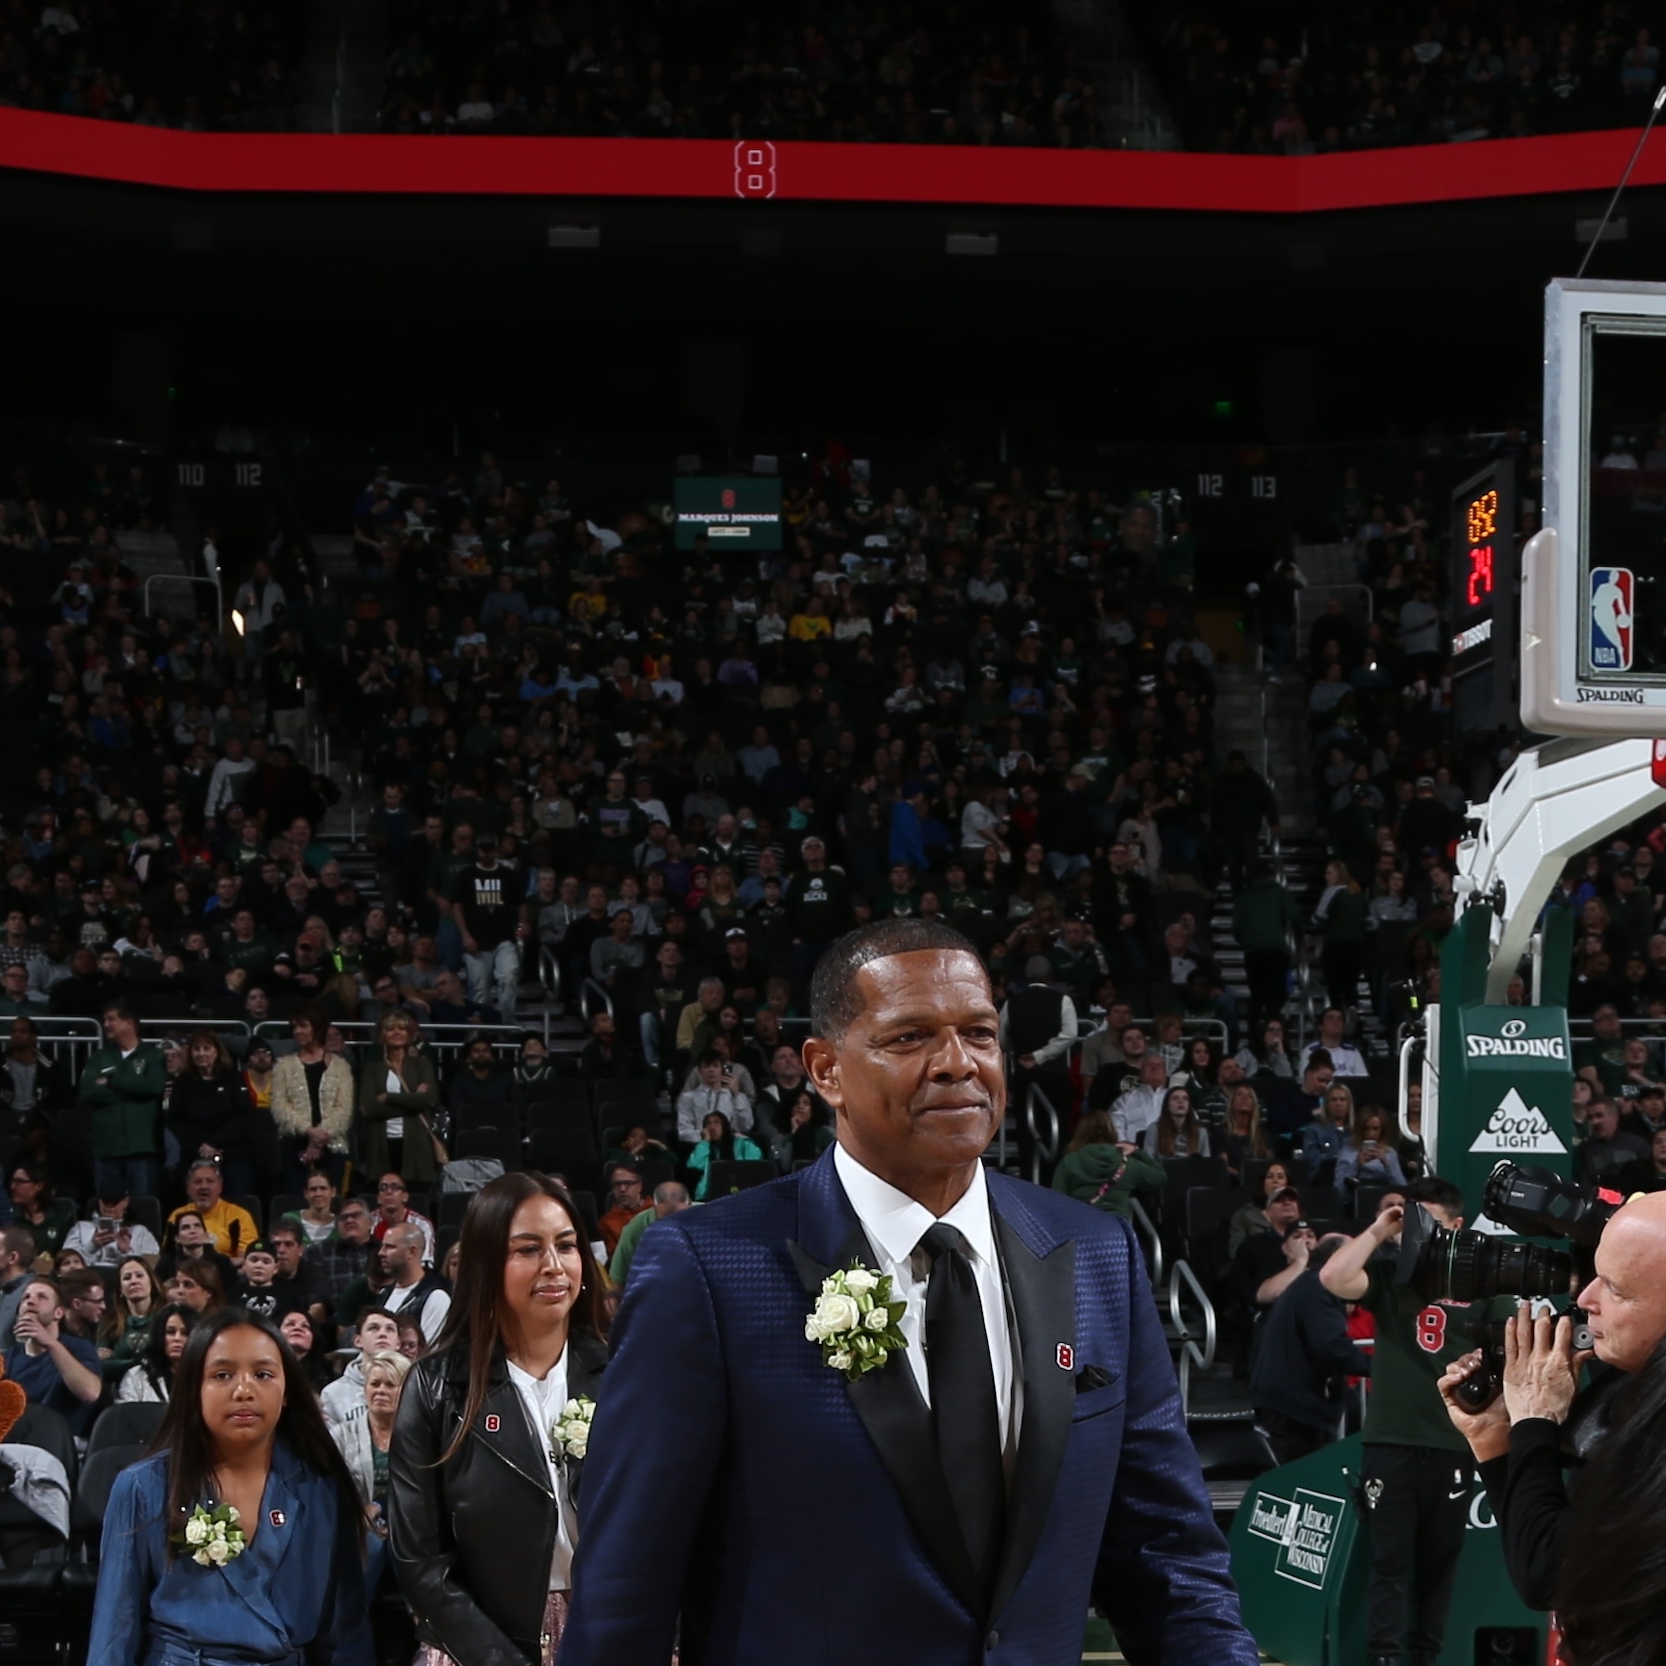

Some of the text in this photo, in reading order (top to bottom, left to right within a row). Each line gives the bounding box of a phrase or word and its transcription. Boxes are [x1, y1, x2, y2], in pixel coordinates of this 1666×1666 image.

[733, 140, 776, 199] 8
[178, 463, 205, 487] 110
[236, 463, 262, 487] 112
[1197, 473, 1224, 497] 112
[1251, 475, 1277, 499] 113
[678, 513, 779, 523] MARQUES JOHNSON
[1468, 545, 1493, 606] 24
[1594, 647, 1617, 665] NBA
[1576, 687, 1645, 704] SPALDING
[1466, 1034, 1567, 1060] SPALDING
[1485, 1108, 1553, 1134] Coors
[1496, 1136, 1540, 1149] LIGHT
[1416, 1304, 1448, 1354] 8
[485, 1413, 501, 1433] 8
[1301, 1502, 1334, 1535] MEDICAL
[1292, 1520, 1325, 1552] COLLEGE
[1286, 1541, 1328, 1575] WISCONSIN
